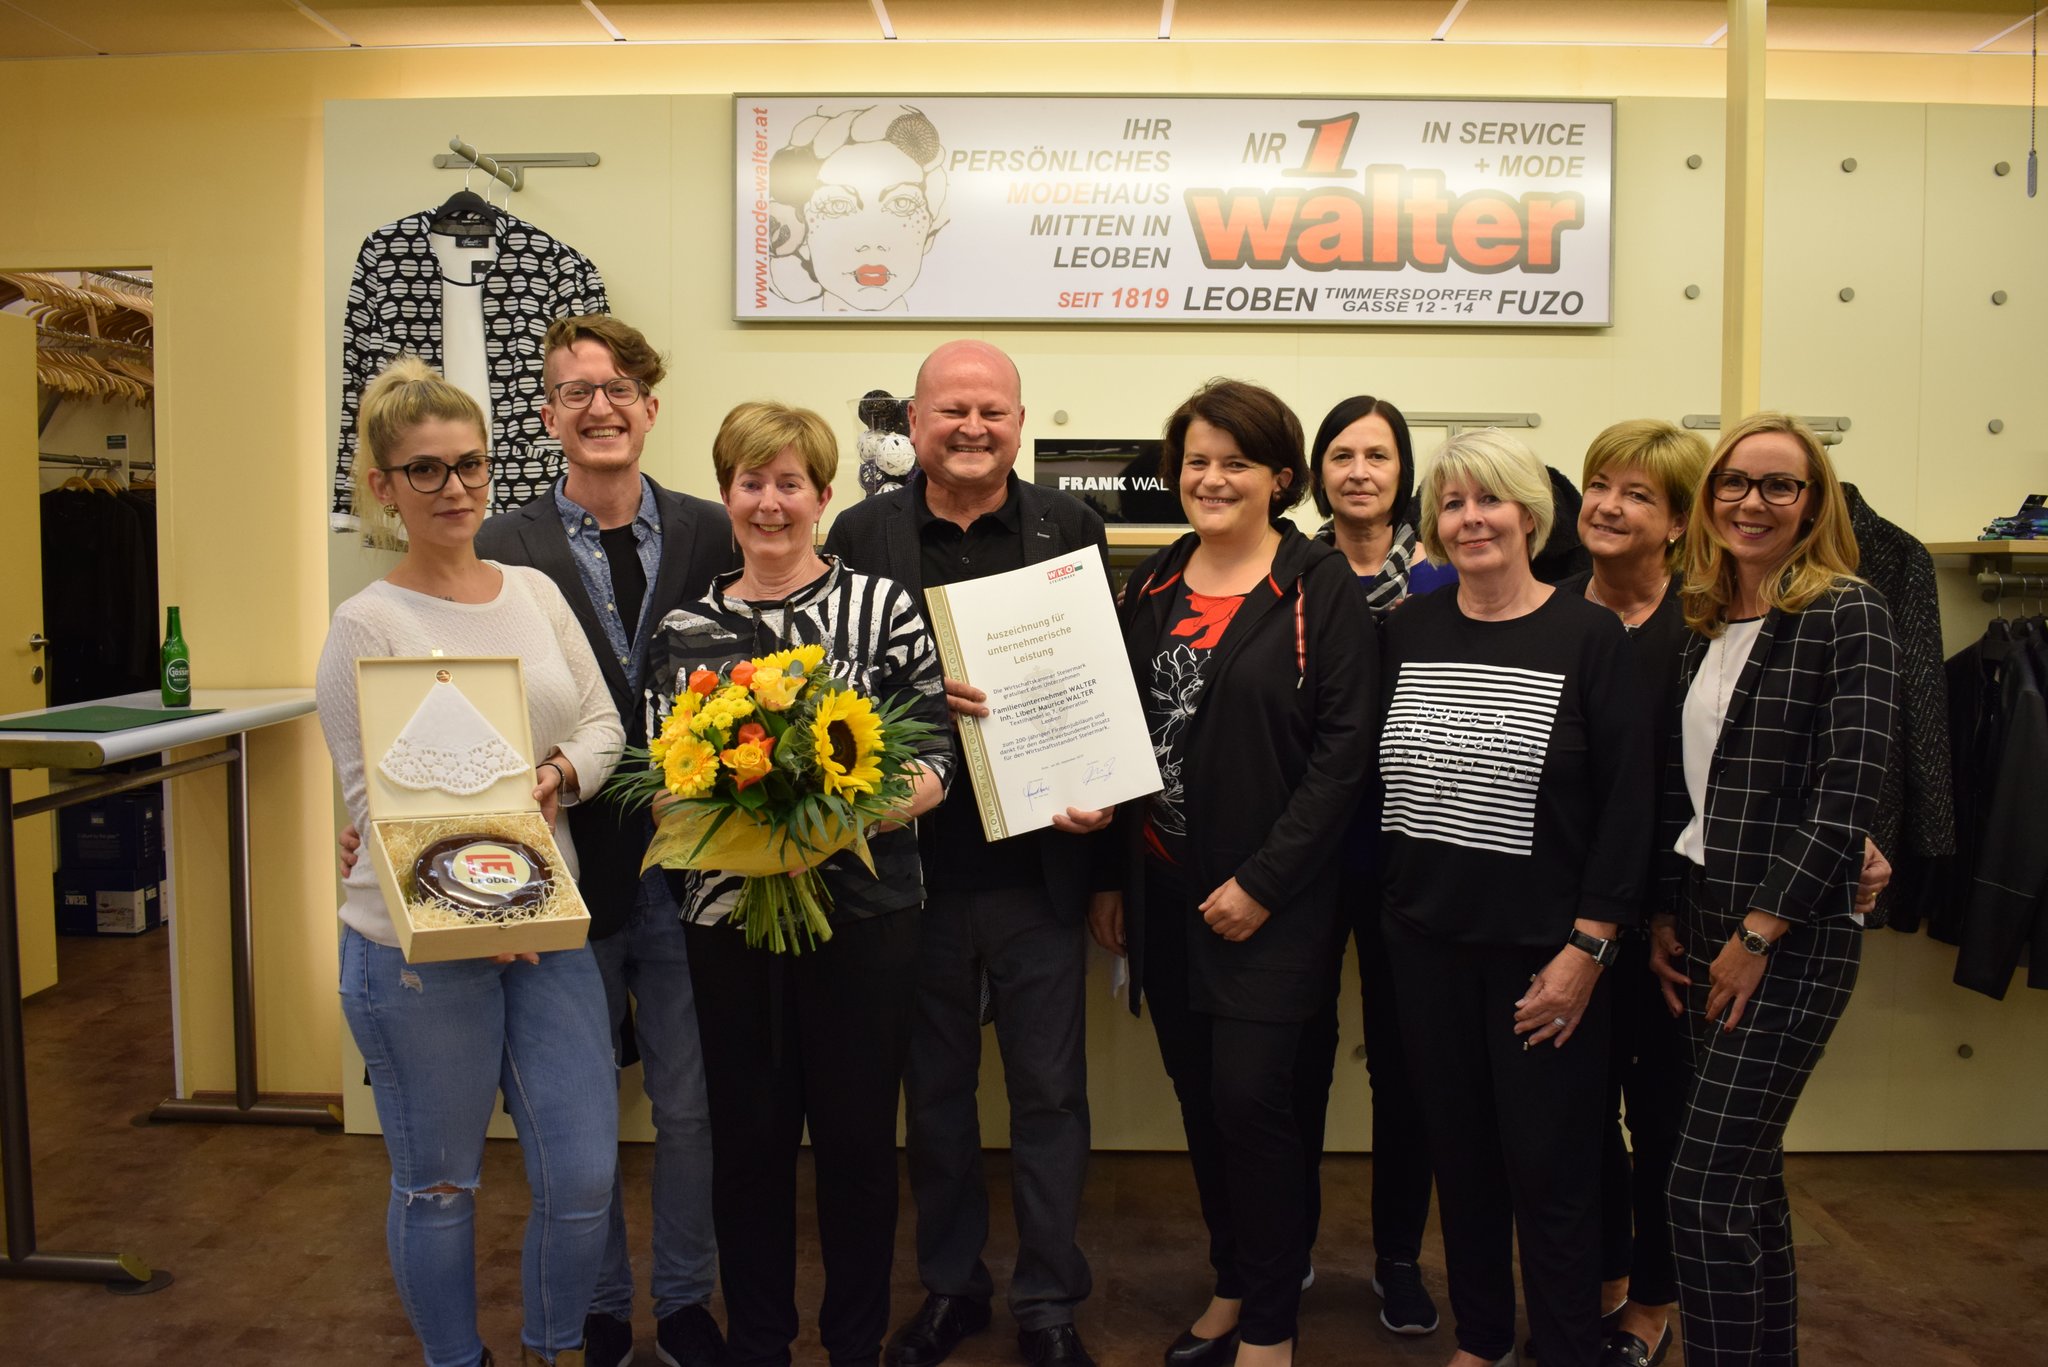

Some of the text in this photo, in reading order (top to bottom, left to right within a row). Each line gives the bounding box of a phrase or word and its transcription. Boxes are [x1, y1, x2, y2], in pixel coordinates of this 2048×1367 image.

[1123, 118, 1172, 140] IHR
[1421, 121, 1586, 146] IN SERVICE
[1242, 112, 1360, 178] NR 1
[949, 146, 1172, 172] PERSÖNLICHES
[1499, 155, 1585, 178] MODE
[1006, 182, 1171, 204] MODEHAUS
[752, 107, 768, 309] www.mode-walter.at
[1183, 163, 1585, 274] walter
[1030, 214, 1171, 236] MITTEN IN
[1053, 246, 1171, 268] LEOBEN
[1057, 287, 1169, 309] SEIT 1819
[1183, 287, 1584, 315] LEOBEN FUZO
[1324, 287, 1492, 301] TIMMERSDORFER
[1342, 301, 1408, 313] GASSE
[1415, 301, 1435, 314] 12
[1453, 302, 1475, 314] 14
[1059, 477, 1169, 491] FRANK WAL
[1047, 565, 1074, 580] WKO
[986, 612, 1065, 641] Auszeichnung für
[988, 625, 1071, 656] unternehmerische
[1014, 647, 1054, 664] Leistung
[1057, 664, 1085, 676] Steiermark
[993, 679, 1097, 715] Familienunternehmen WALTER
[1004, 689, 1029, 699] gratuliert
[1044, 673, 1080, 687] Unternehmen
[1000, 689, 1094, 723] Inh. Libert Maurice WALTER
[1059, 699, 1088, 712] Generation
[1041, 715, 1061, 724] Leoben
[1000, 747, 1016, 756] dankt
[1055, 725, 1090, 738] verbundenen
[1092, 718, 1110, 727] Einsatz
[1025, 736, 1078, 755] Wirtschaftsstandort
